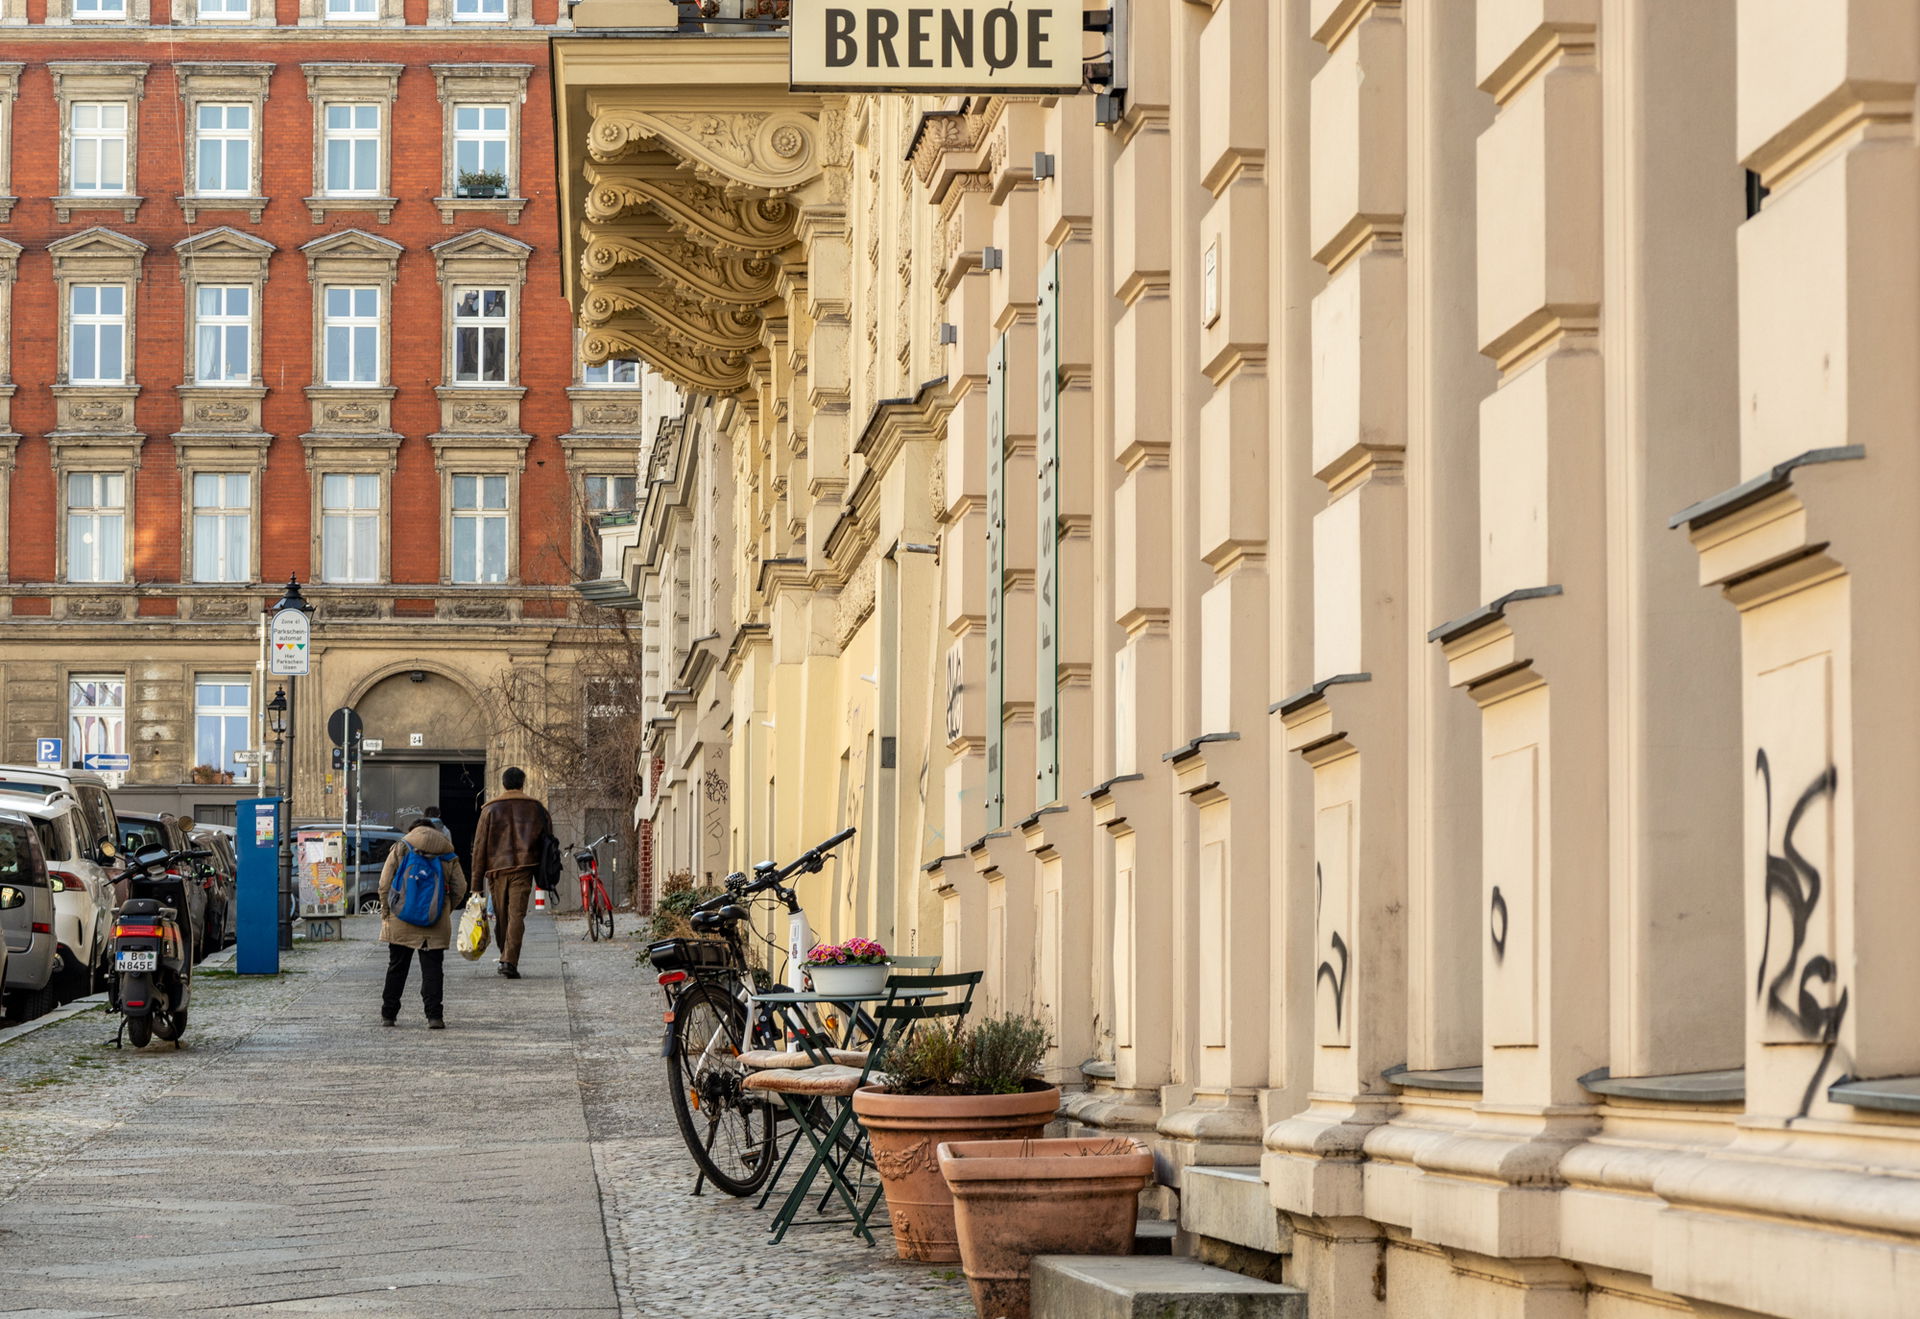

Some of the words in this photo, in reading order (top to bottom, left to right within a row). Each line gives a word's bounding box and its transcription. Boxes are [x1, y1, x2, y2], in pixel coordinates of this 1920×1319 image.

[825, 1, 1053, 76] BRENØE
[1042, 312, 1052, 650] FASHION
[990, 408, 999, 674] NORDIC
[41, 741, 55, 760] P
[131, 952, 138, 960] B
